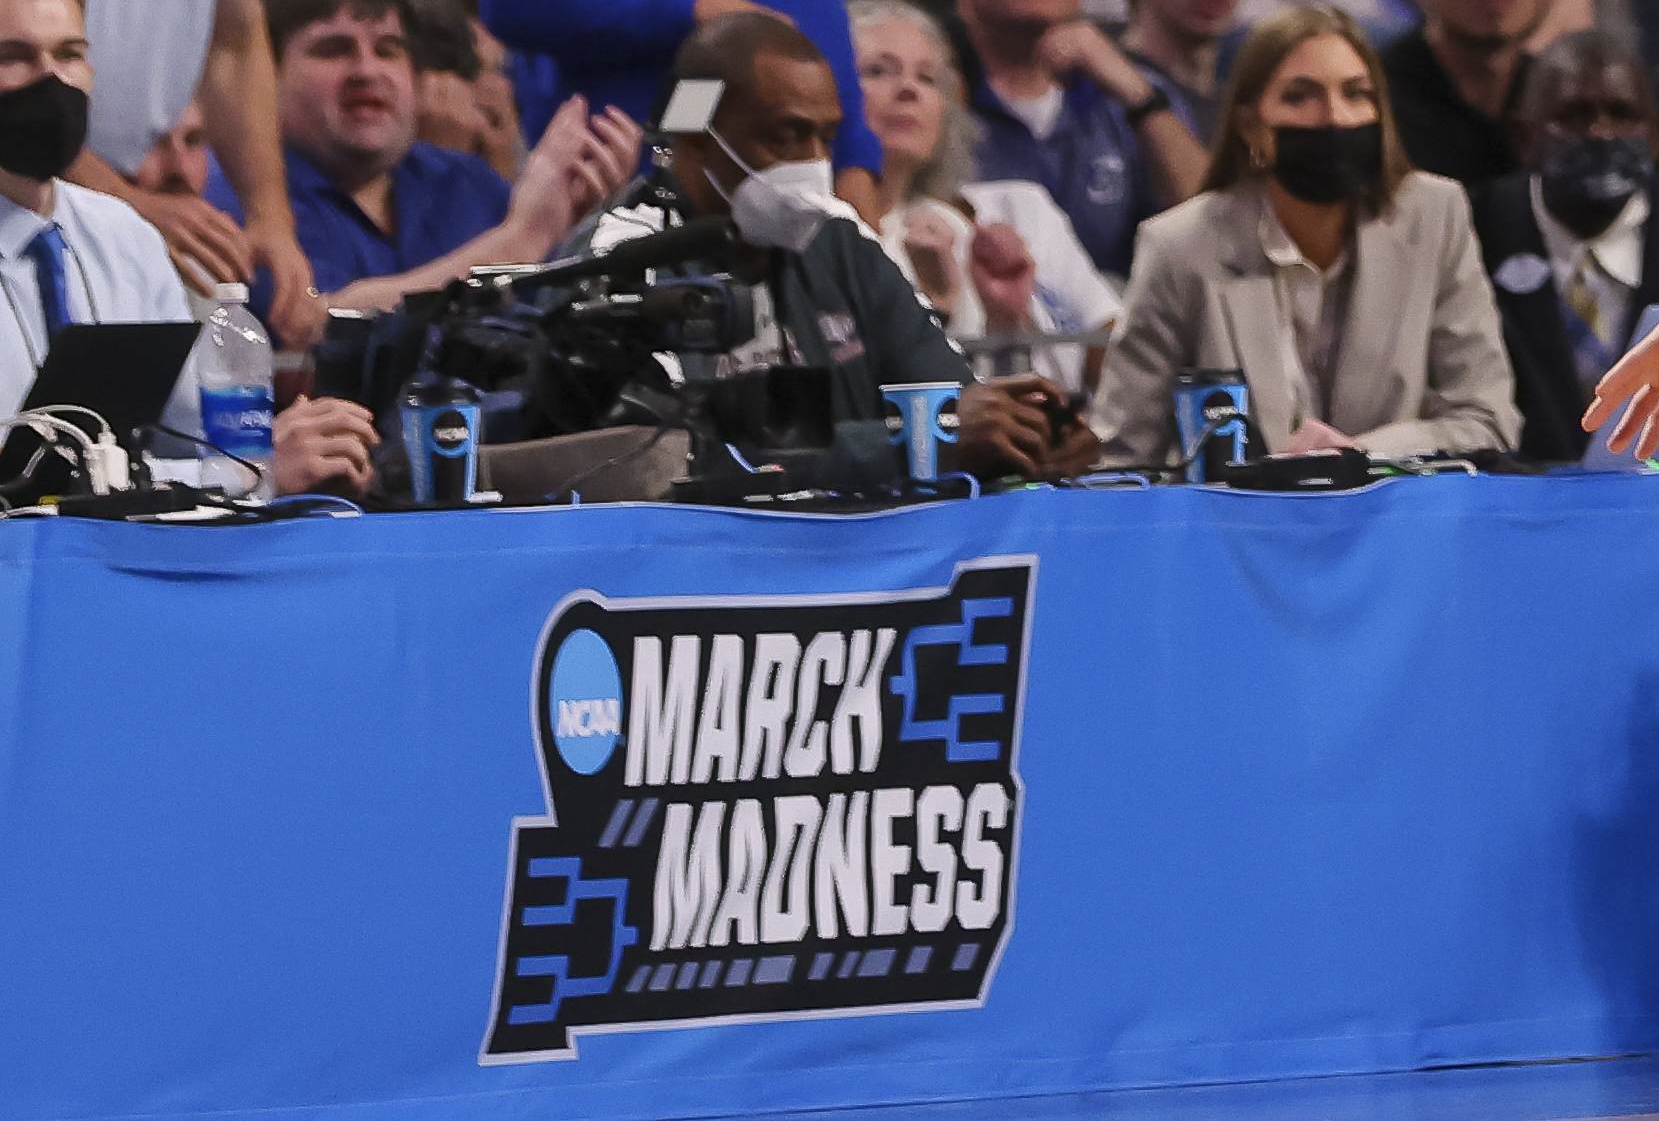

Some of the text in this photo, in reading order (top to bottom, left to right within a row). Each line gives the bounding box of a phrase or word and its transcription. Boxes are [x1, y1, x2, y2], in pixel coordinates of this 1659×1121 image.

[556, 698, 620, 738] NCAA
[623, 627, 898, 787] MARCH
[648, 782, 1009, 951] MADNESS
